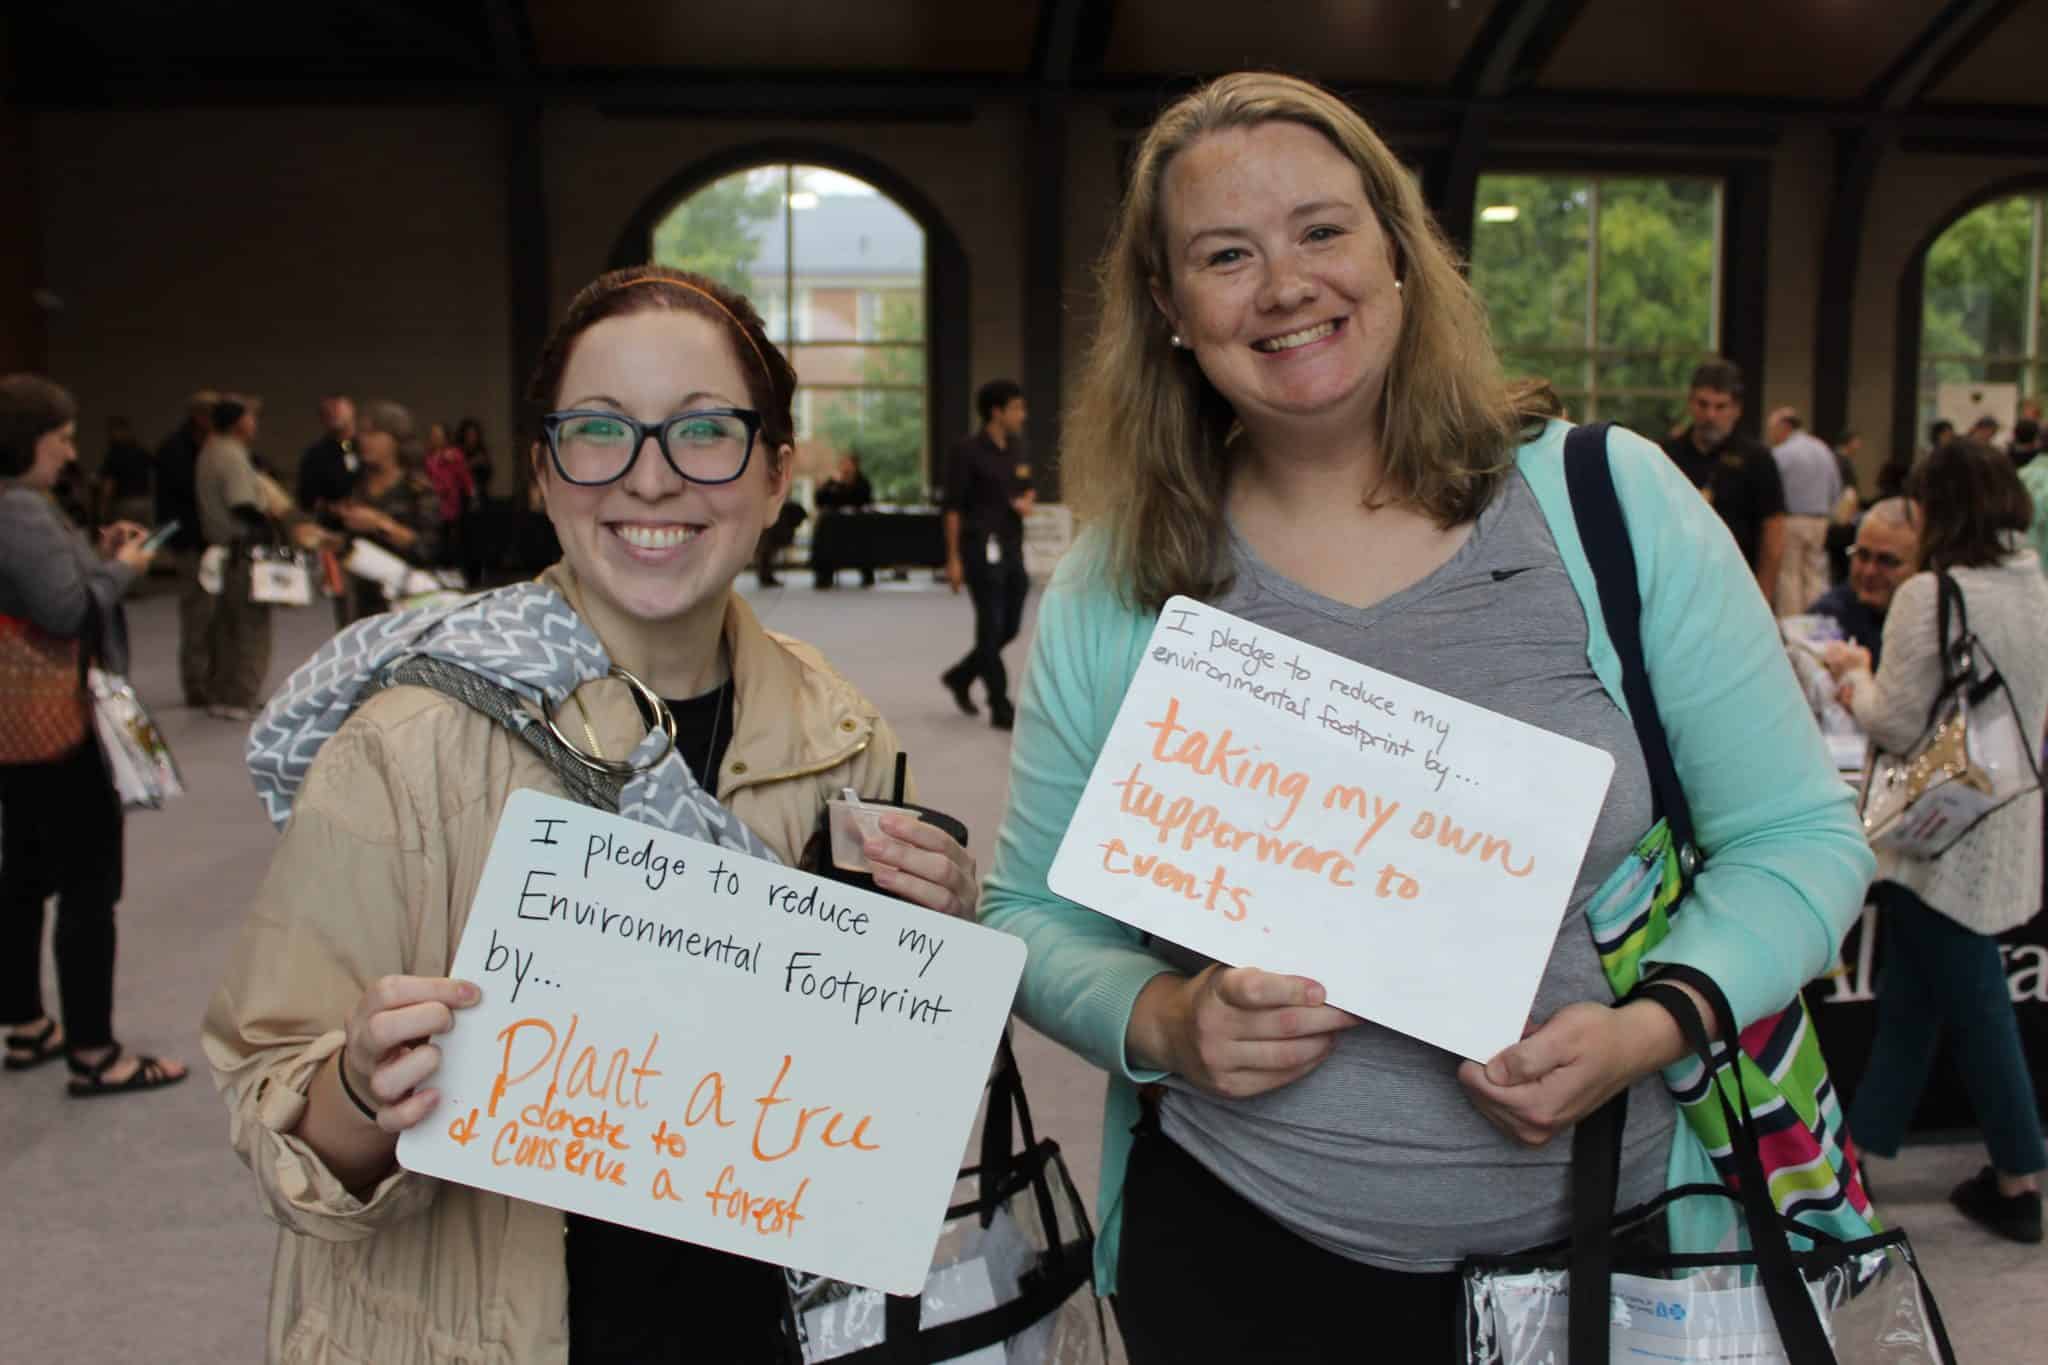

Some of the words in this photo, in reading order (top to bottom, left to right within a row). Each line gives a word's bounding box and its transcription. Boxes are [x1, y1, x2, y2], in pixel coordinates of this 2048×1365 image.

[1152, 645, 1310, 720] environmental
[1317, 703, 1414, 758] footprint
[1425, 751, 1480, 792] by...
[1166, 610, 1200, 635] I
[1210, 624, 1275, 676] pledge
[1284, 654, 1311, 681] to
[1330, 678, 1396, 716] reduce
[1413, 708, 1450, 754] my
[1113, 761, 1356, 888] tupperware
[1376, 864, 1419, 900] to
[1146, 697, 1310, 832] taking
[1323, 785, 1400, 855] my
[1411, 811, 1534, 877] own
[485, 929, 562, 1003] by...
[517, 870, 761, 974] Environmental
[785, 952, 952, 1025] Footprint
[529, 819, 568, 845] I
[584, 833, 686, 890] pledge
[708, 861, 740, 895] to
[769, 884, 869, 936] reduce
[898, 928, 944, 978] my
[488, 1014, 663, 1118] Plant
[684, 1072, 736, 1127] a
[752, 1055, 880, 1162] tree
[521, 1083, 631, 1149] donate
[651, 1119, 686, 1158] to
[652, 1168, 682, 1201] a
[705, 1165, 811, 1237] forest
